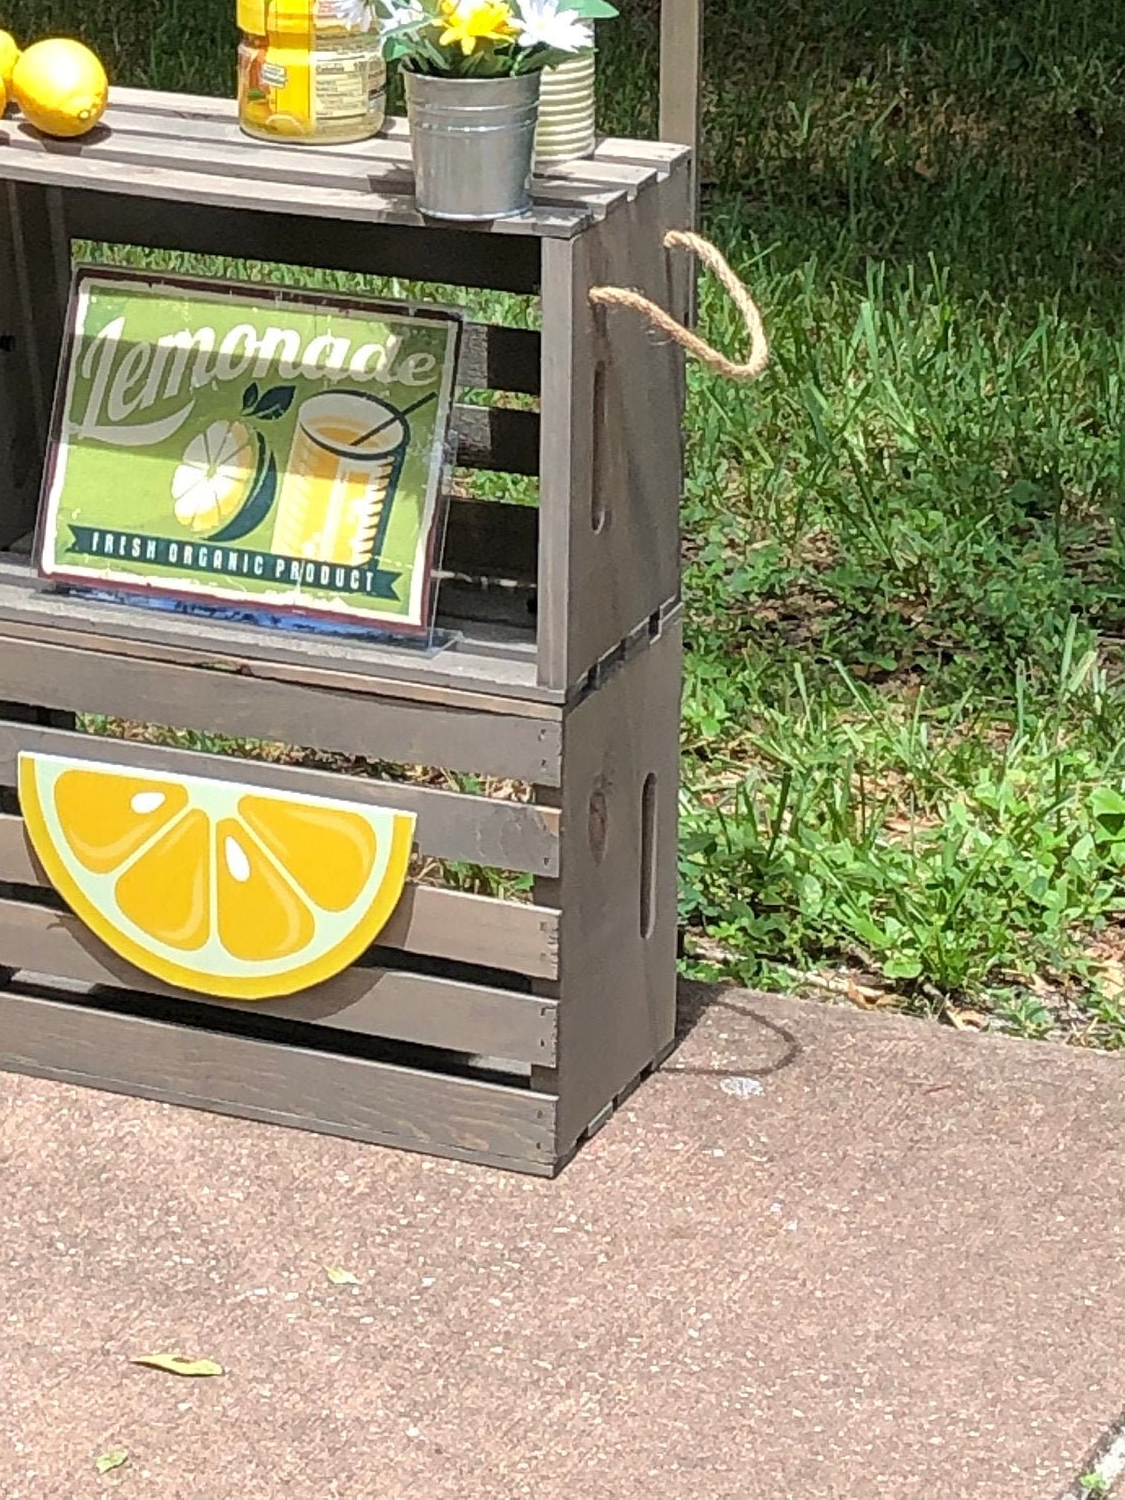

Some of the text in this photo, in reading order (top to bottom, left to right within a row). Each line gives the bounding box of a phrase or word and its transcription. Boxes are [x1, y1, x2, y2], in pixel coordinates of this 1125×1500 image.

[67, 315, 440, 446] Lemonade
[91, 532, 375, 592] FRESH ORGANIC PRODUCT
